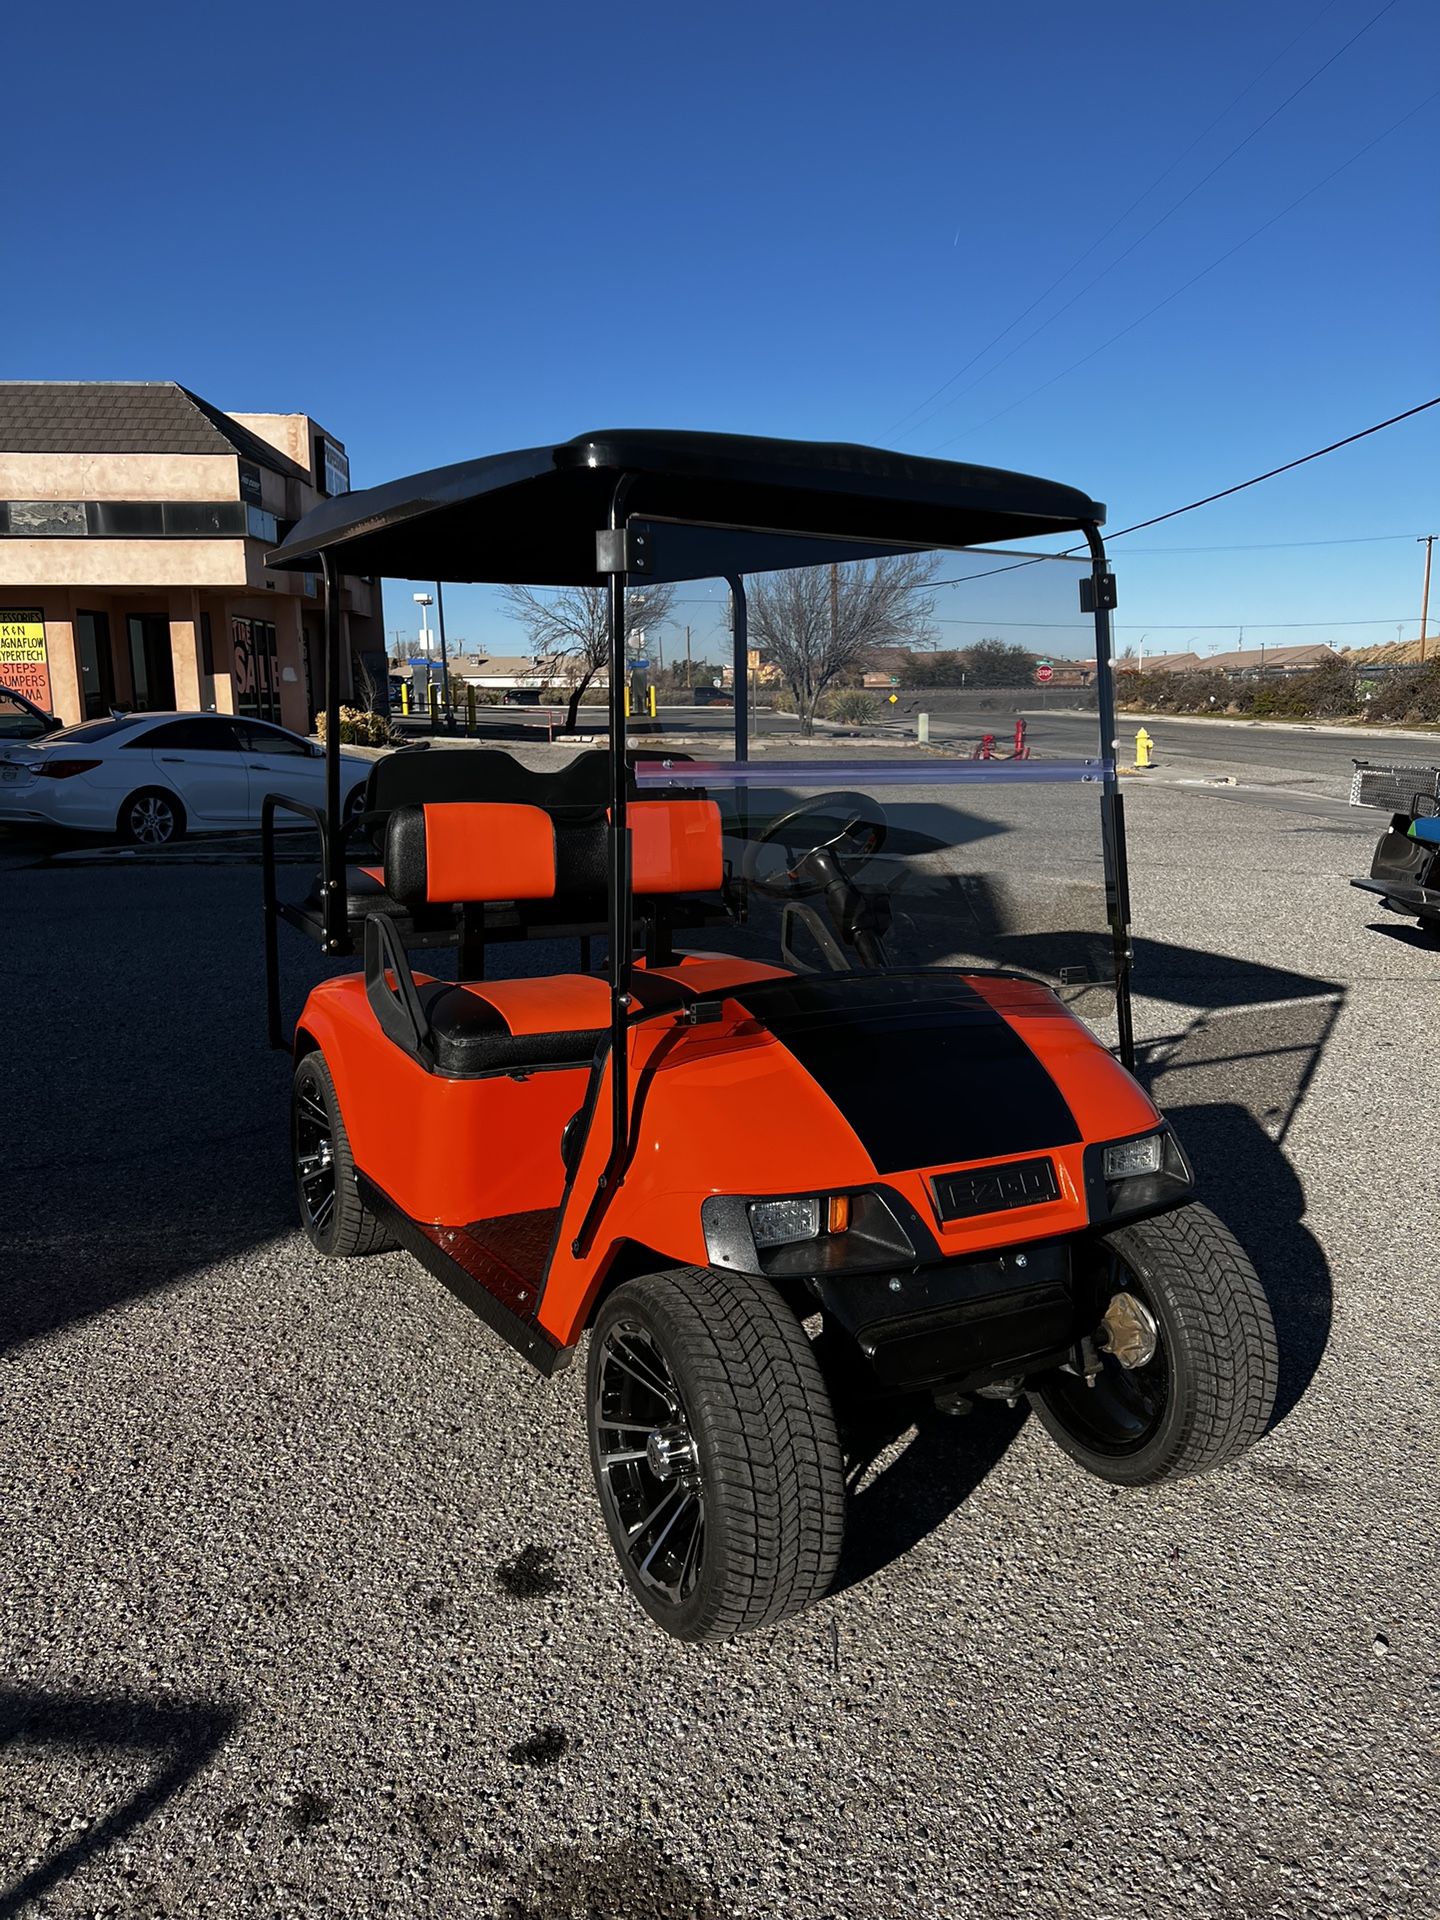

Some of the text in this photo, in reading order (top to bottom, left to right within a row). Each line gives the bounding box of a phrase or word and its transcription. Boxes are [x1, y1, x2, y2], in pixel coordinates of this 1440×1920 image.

[0, 638, 44, 648] AGNAFLOW
[0, 650, 44, 661] YPERTECH
[3, 663, 37, 673] STEPS
[235, 645, 280, 694] SALE
[1038, 669, 1052, 677] STOP
